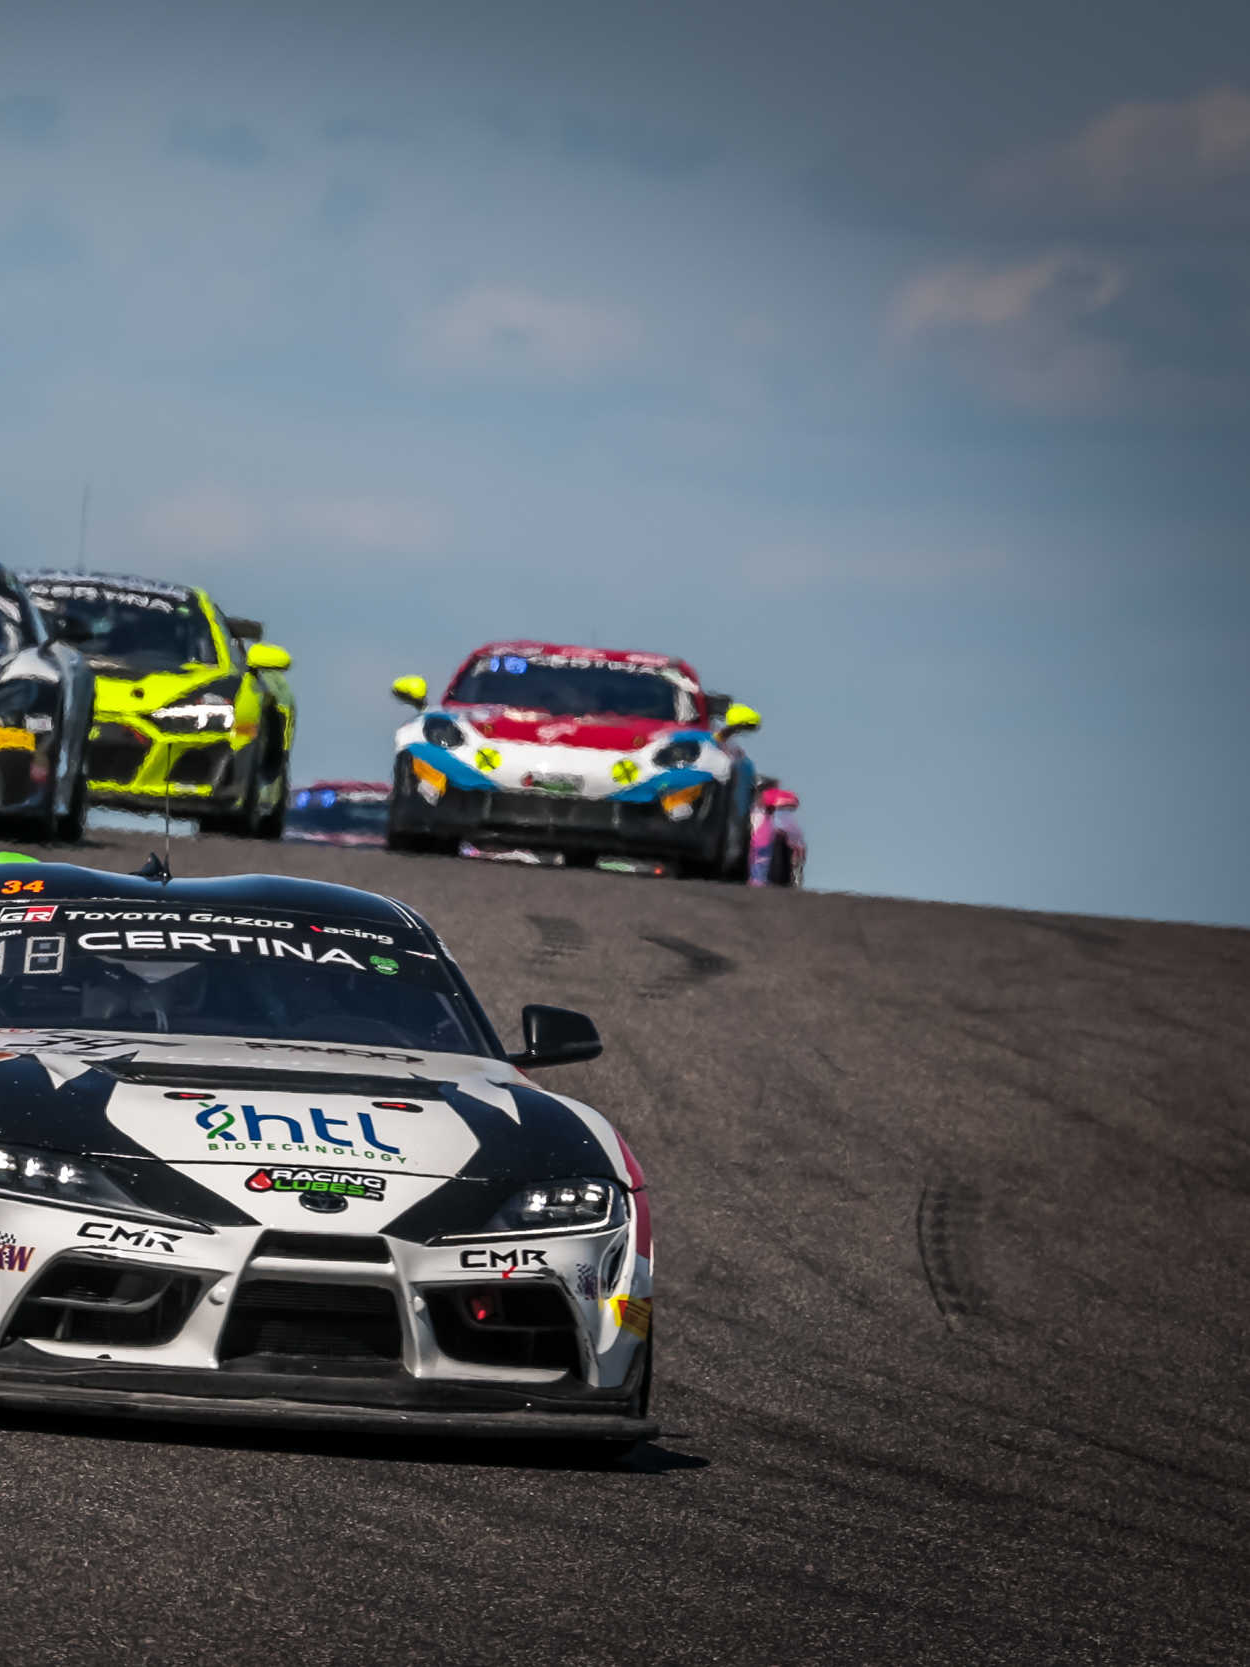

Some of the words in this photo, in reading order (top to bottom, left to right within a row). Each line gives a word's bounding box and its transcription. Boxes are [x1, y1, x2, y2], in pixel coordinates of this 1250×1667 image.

[0, 880, 45, 894] 34
[65, 911, 182, 922] TOYOTA
[188, 913, 295, 929] GAZOO
[310, 925, 395, 945] acing
[77, 931, 367, 971] CERTINA
[207, 1142, 407, 1165] BIOTECHNOLOGY
[272, 1169, 382, 1189] RACING
[77, 1221, 183, 1253] CMR
[459, 1249, 549, 1268] CMR
